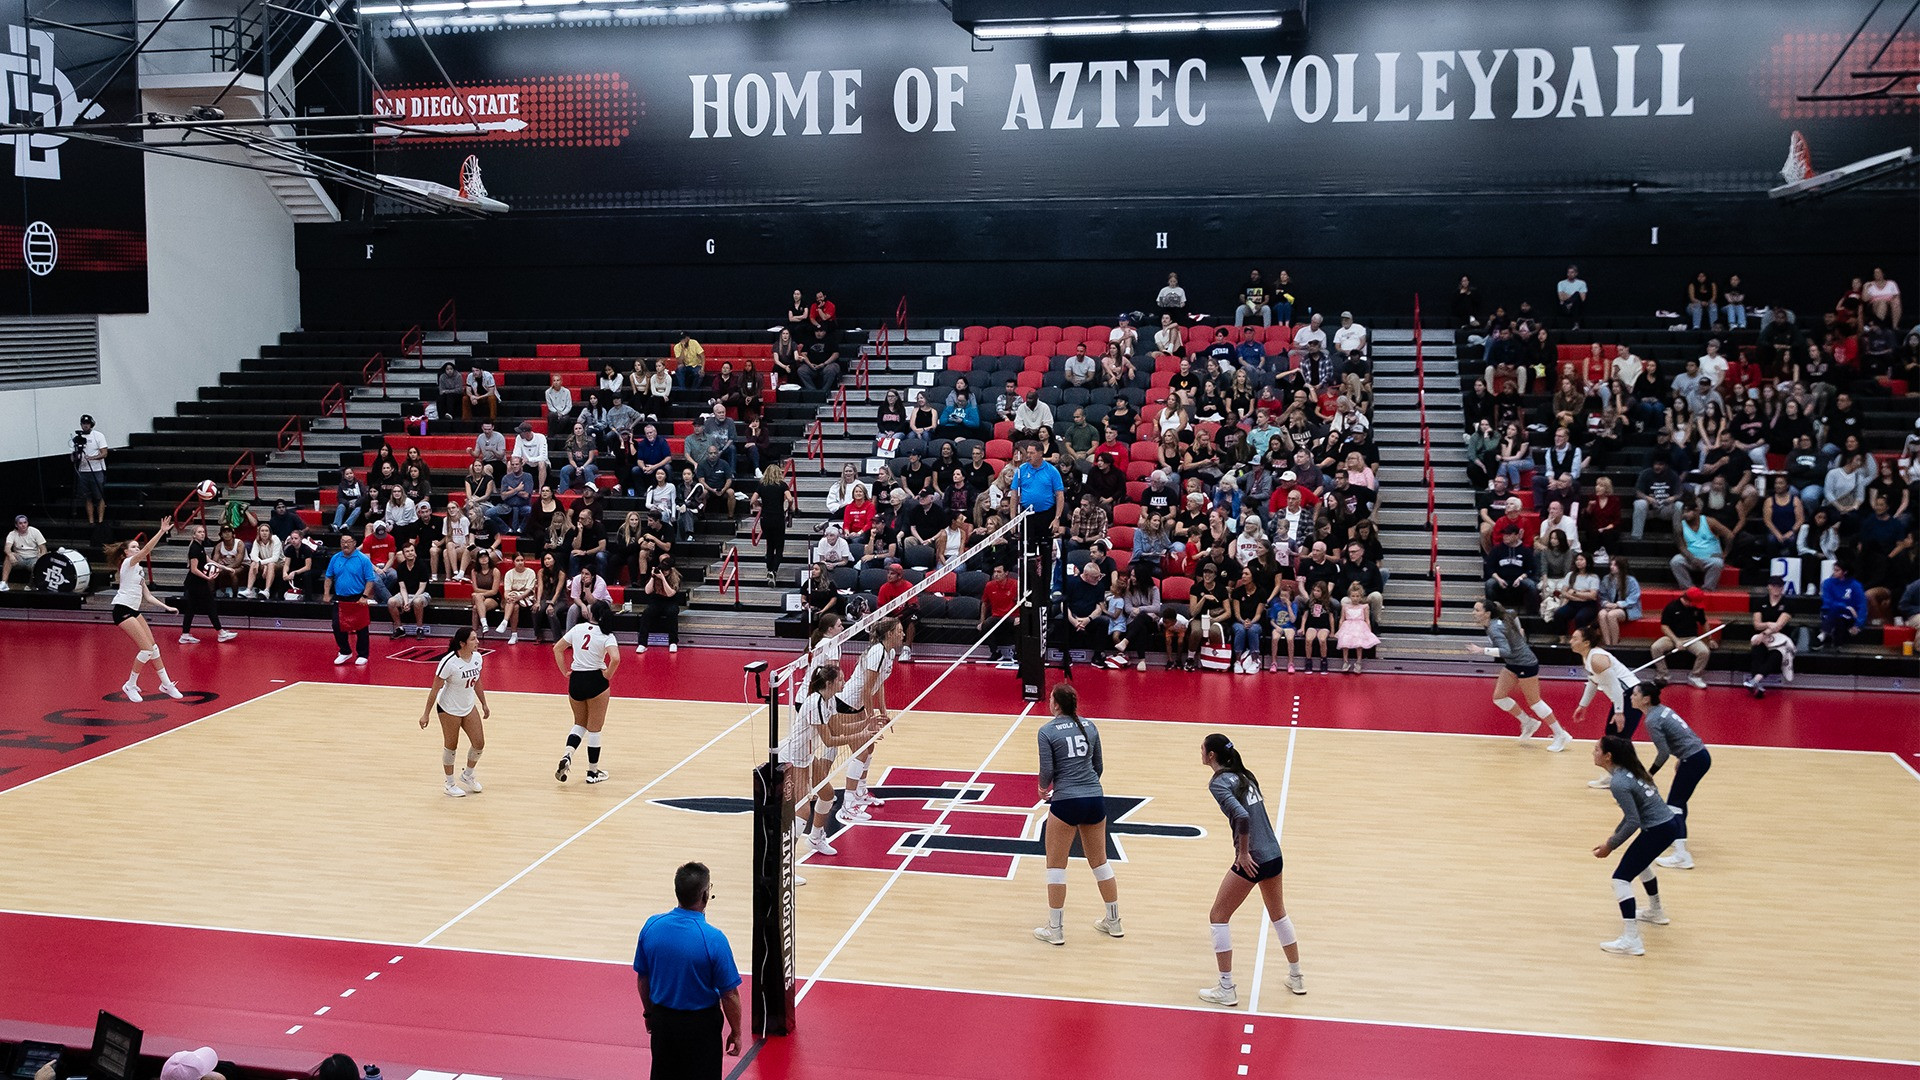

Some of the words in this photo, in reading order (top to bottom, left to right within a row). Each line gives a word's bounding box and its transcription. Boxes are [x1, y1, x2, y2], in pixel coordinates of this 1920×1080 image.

[688, 69, 862, 139] HOME
[893, 64, 969, 133] OF
[1001, 58, 1207, 131] AZTEC
[1240, 43, 1694, 124] VOLLEYBALL
[411, 96, 464, 118] DIEGO
[468, 93, 519, 116] STATE
[1156, 232, 1168, 249] H
[1651, 226, 1659, 245] I
[366, 244, 374, 259] F
[705, 238, 715, 255] G
[581, 634, 591, 650] 2
[465, 677, 476, 688] 16
[1056, 722, 1073, 731] WOLF
[1065, 734, 1089, 758] 15
[782, 829, 792, 889] STATE
[782, 890, 792, 952] DIEGO
[784, 955, 793, 991] SAN
